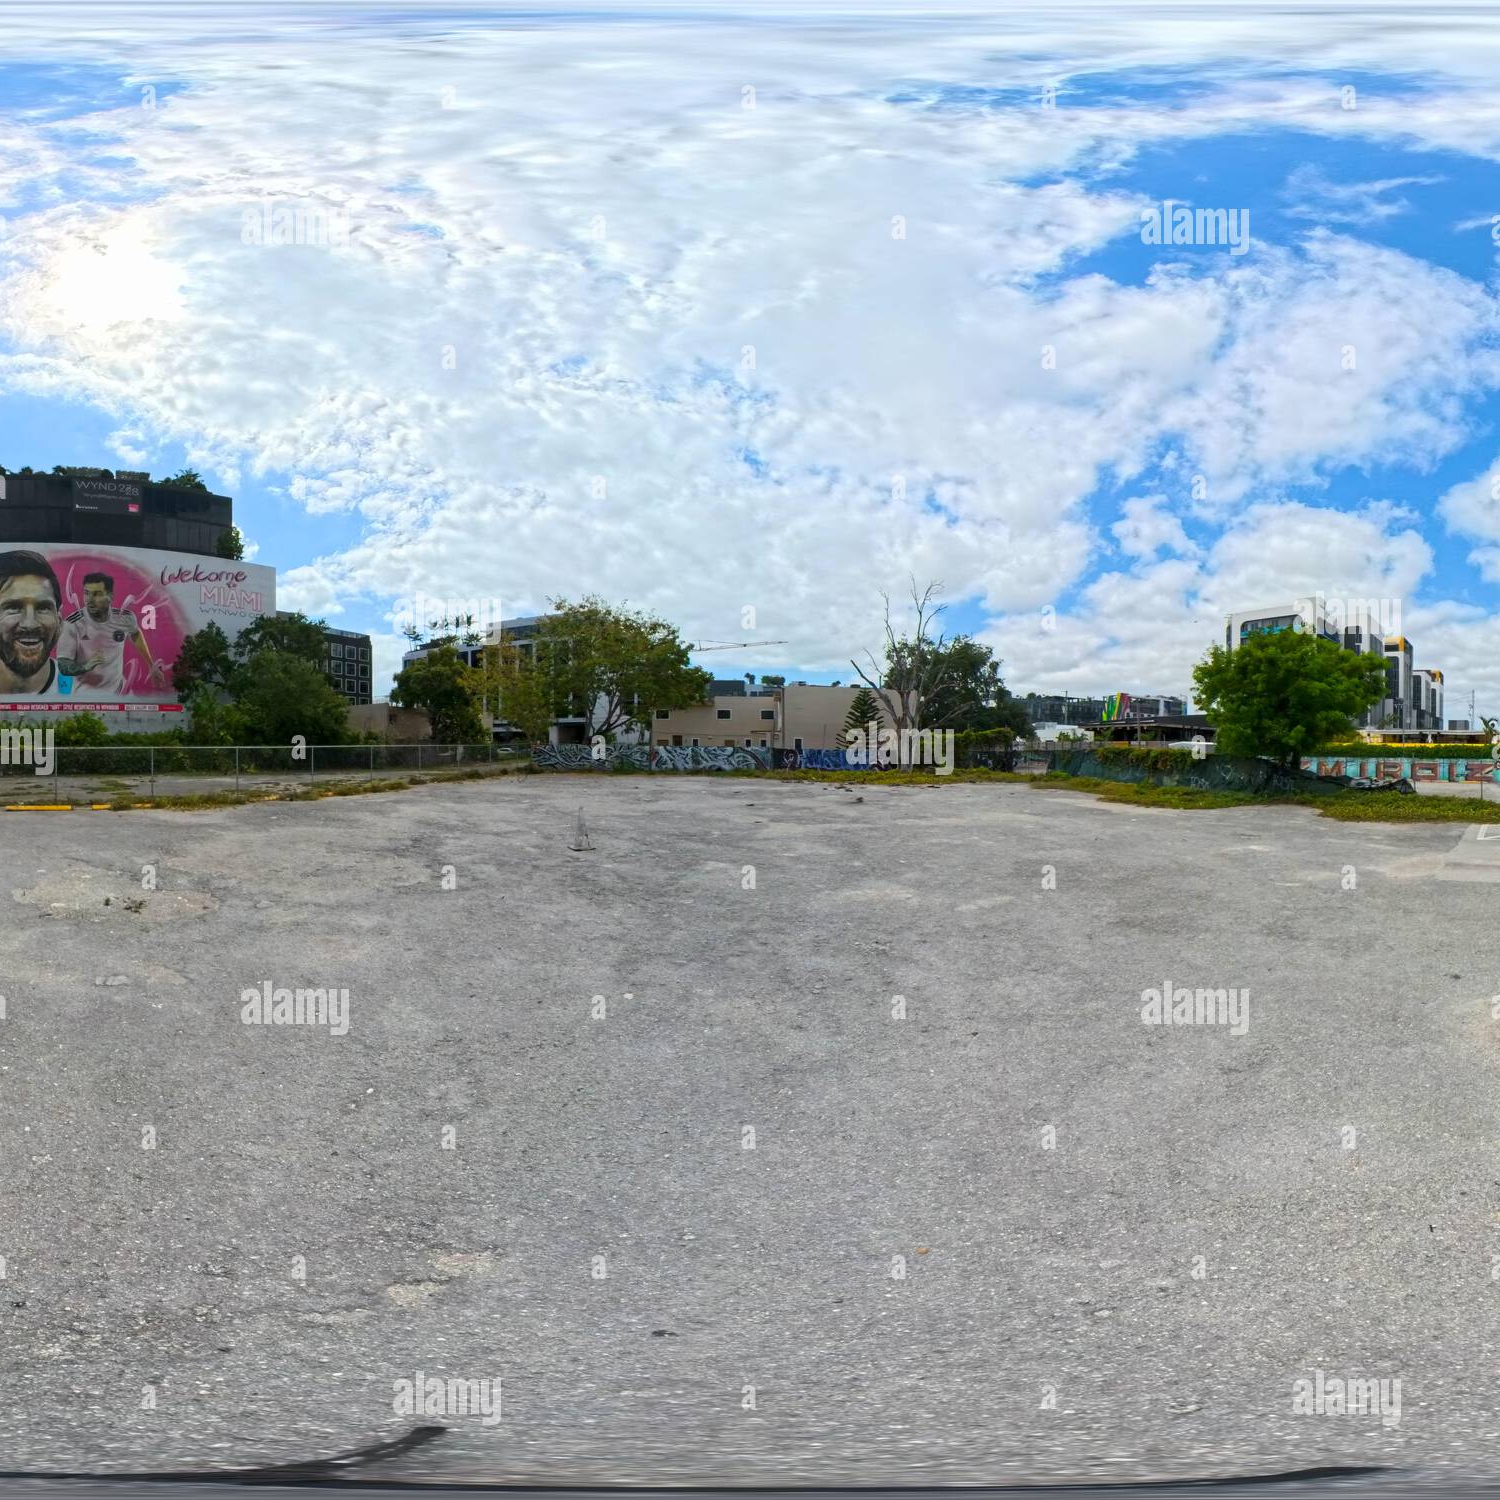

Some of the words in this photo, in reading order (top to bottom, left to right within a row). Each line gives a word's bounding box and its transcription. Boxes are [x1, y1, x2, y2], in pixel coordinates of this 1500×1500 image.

[75, 480, 117, 491] WYND
[161, 564, 247, 586] Welcome
[199, 584, 261, 612] MIAMI
